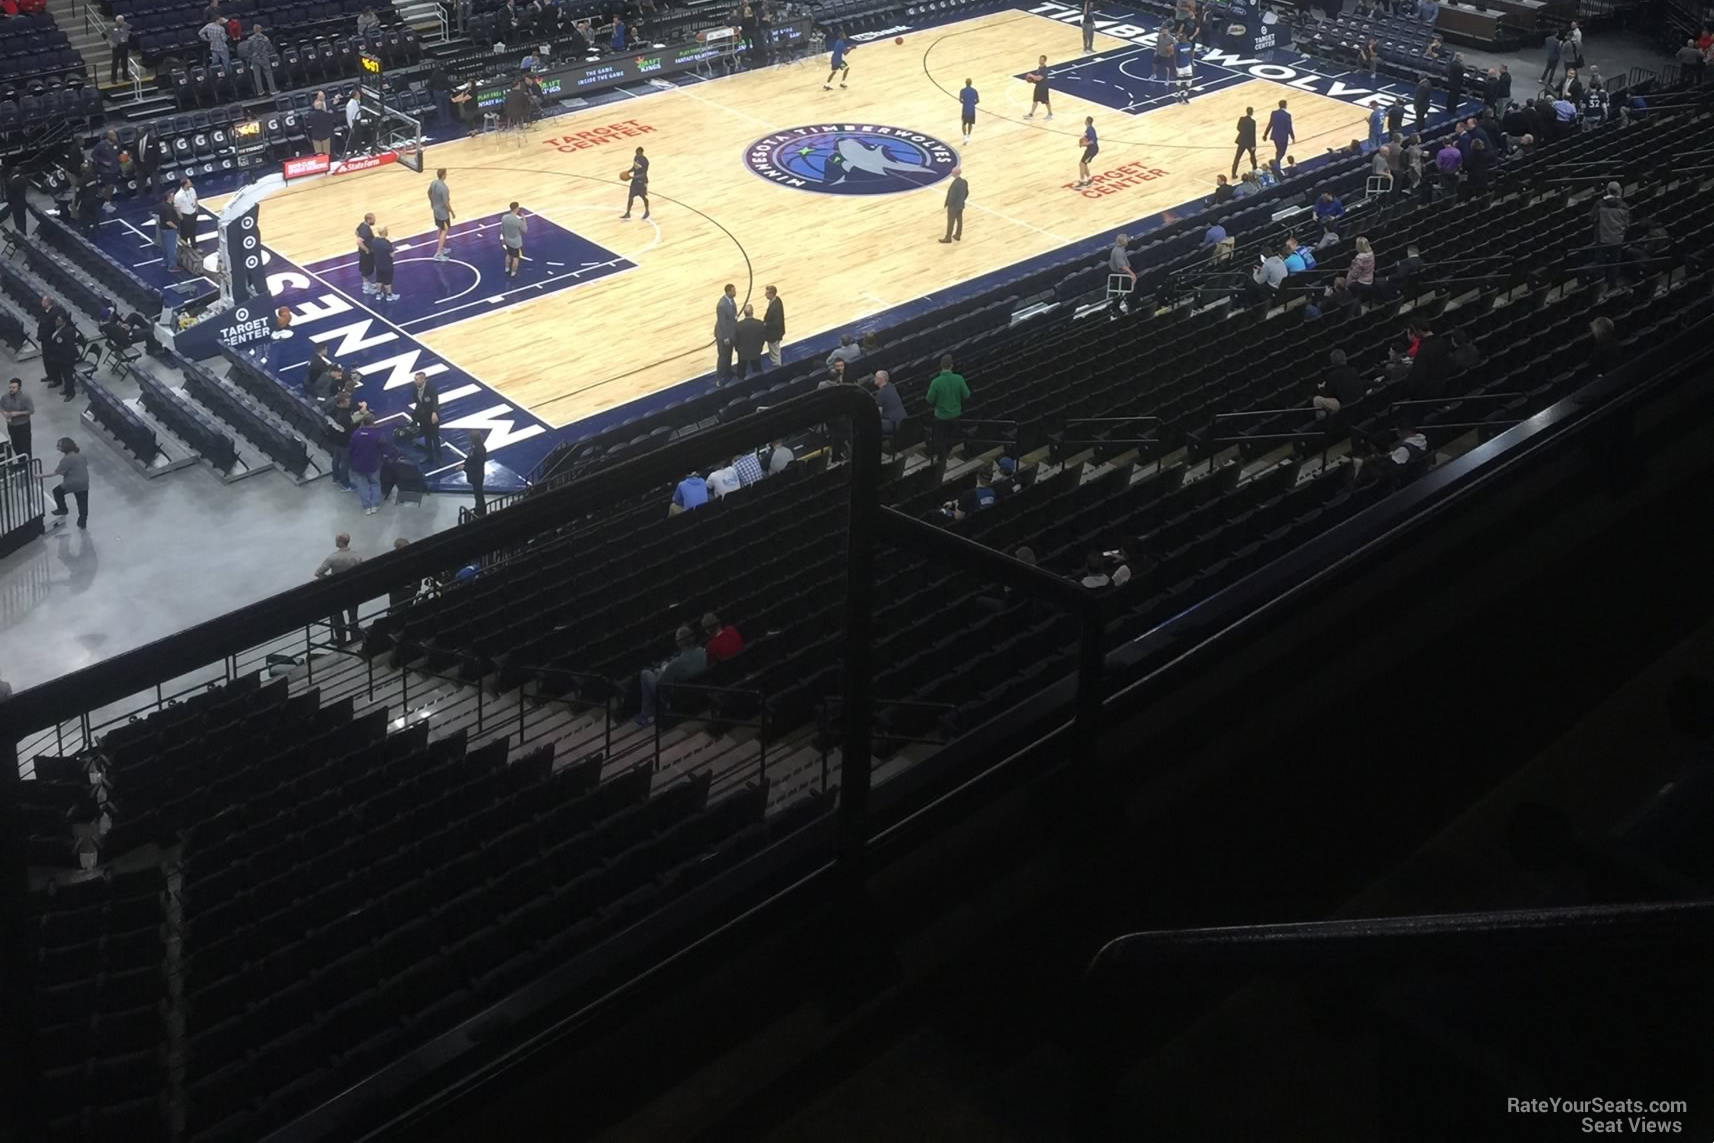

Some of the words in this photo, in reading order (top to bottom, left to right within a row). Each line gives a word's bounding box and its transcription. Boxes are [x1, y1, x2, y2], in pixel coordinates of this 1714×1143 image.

[1254, 33, 1275, 44] TARGET
[1254, 40, 1275, 51] CENTER
[598, 67, 613, 75] GAME
[640, 64, 661, 73] KINGS
[577, 77, 596, 86] INSIDE
[608, 71, 624, 79] GAME
[1589, 99, 1600, 108] 32
[268, 119, 278, 130] G
[285, 115, 295, 126] G
[214, 131, 224, 142] G
[542, 119, 640, 146] TARGET
[177, 138, 187, 149] G
[195, 135, 206, 146] G
[557, 125, 657, 153] CENTER
[793, 124, 952, 164] TIMBERWOLVES
[751, 134, 806, 187] MINNESOTA
[1060, 161, 1148, 188] TRGET
[1082, 168, 1170, 199] CENTER
[220, 317, 268, 338] TARGET
